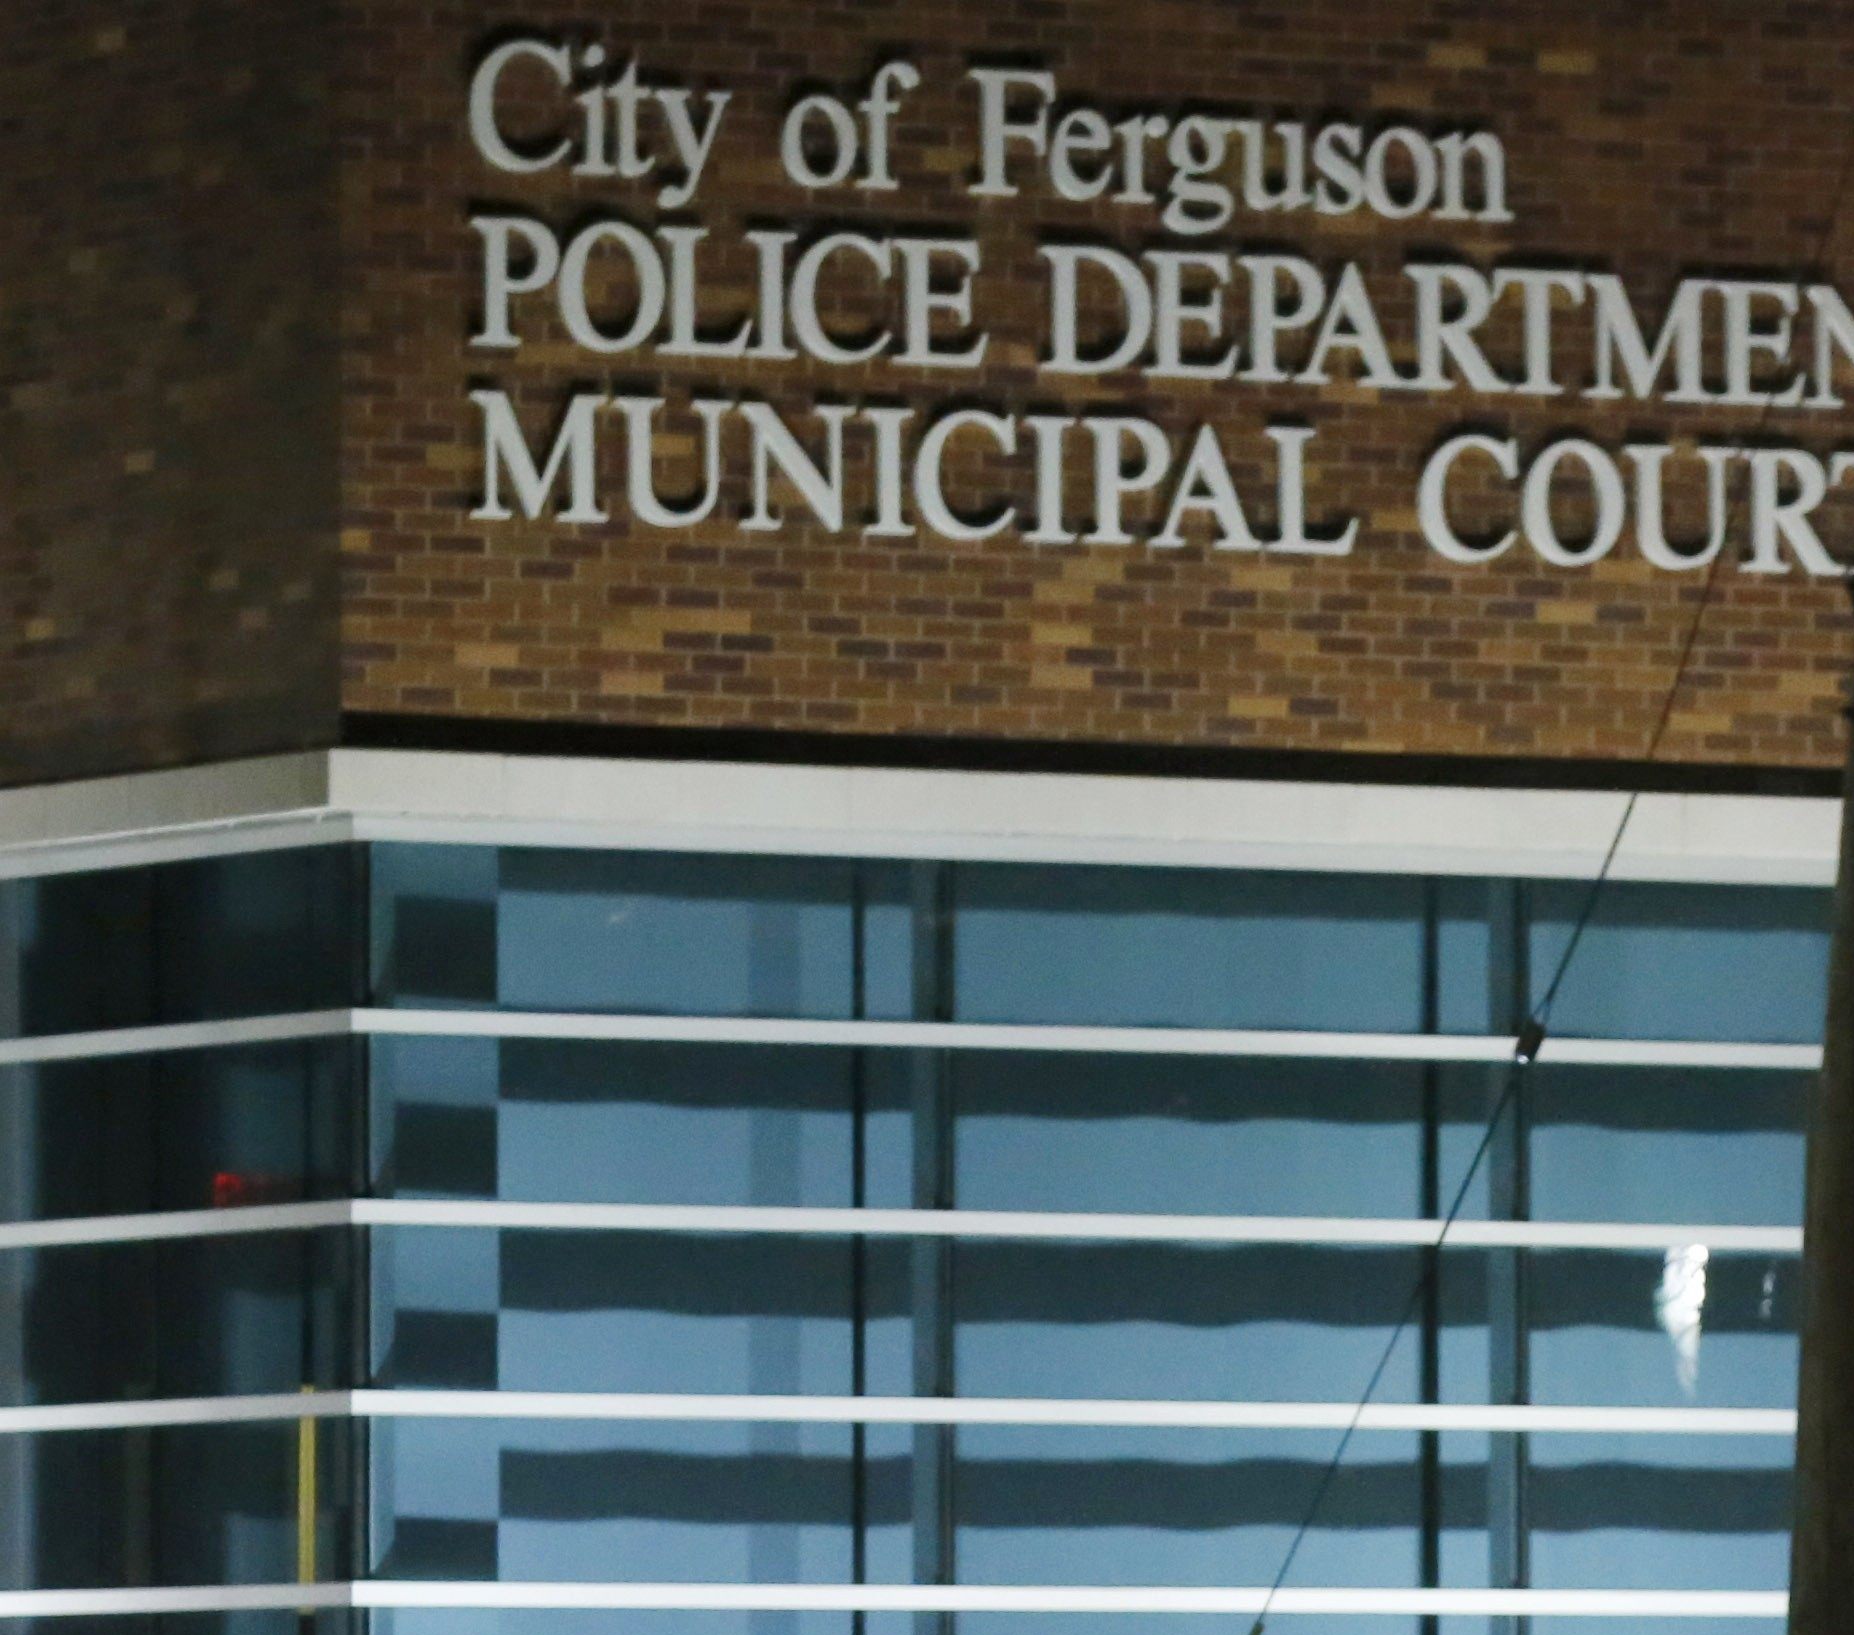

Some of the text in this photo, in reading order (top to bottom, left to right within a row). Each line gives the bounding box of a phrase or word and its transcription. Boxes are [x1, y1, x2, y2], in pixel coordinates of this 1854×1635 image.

[469, 39, 1514, 235] City of Ferguson
[470, 215, 989, 368] POLICE
[469, 390, 1360, 558] MUNICIPAL
